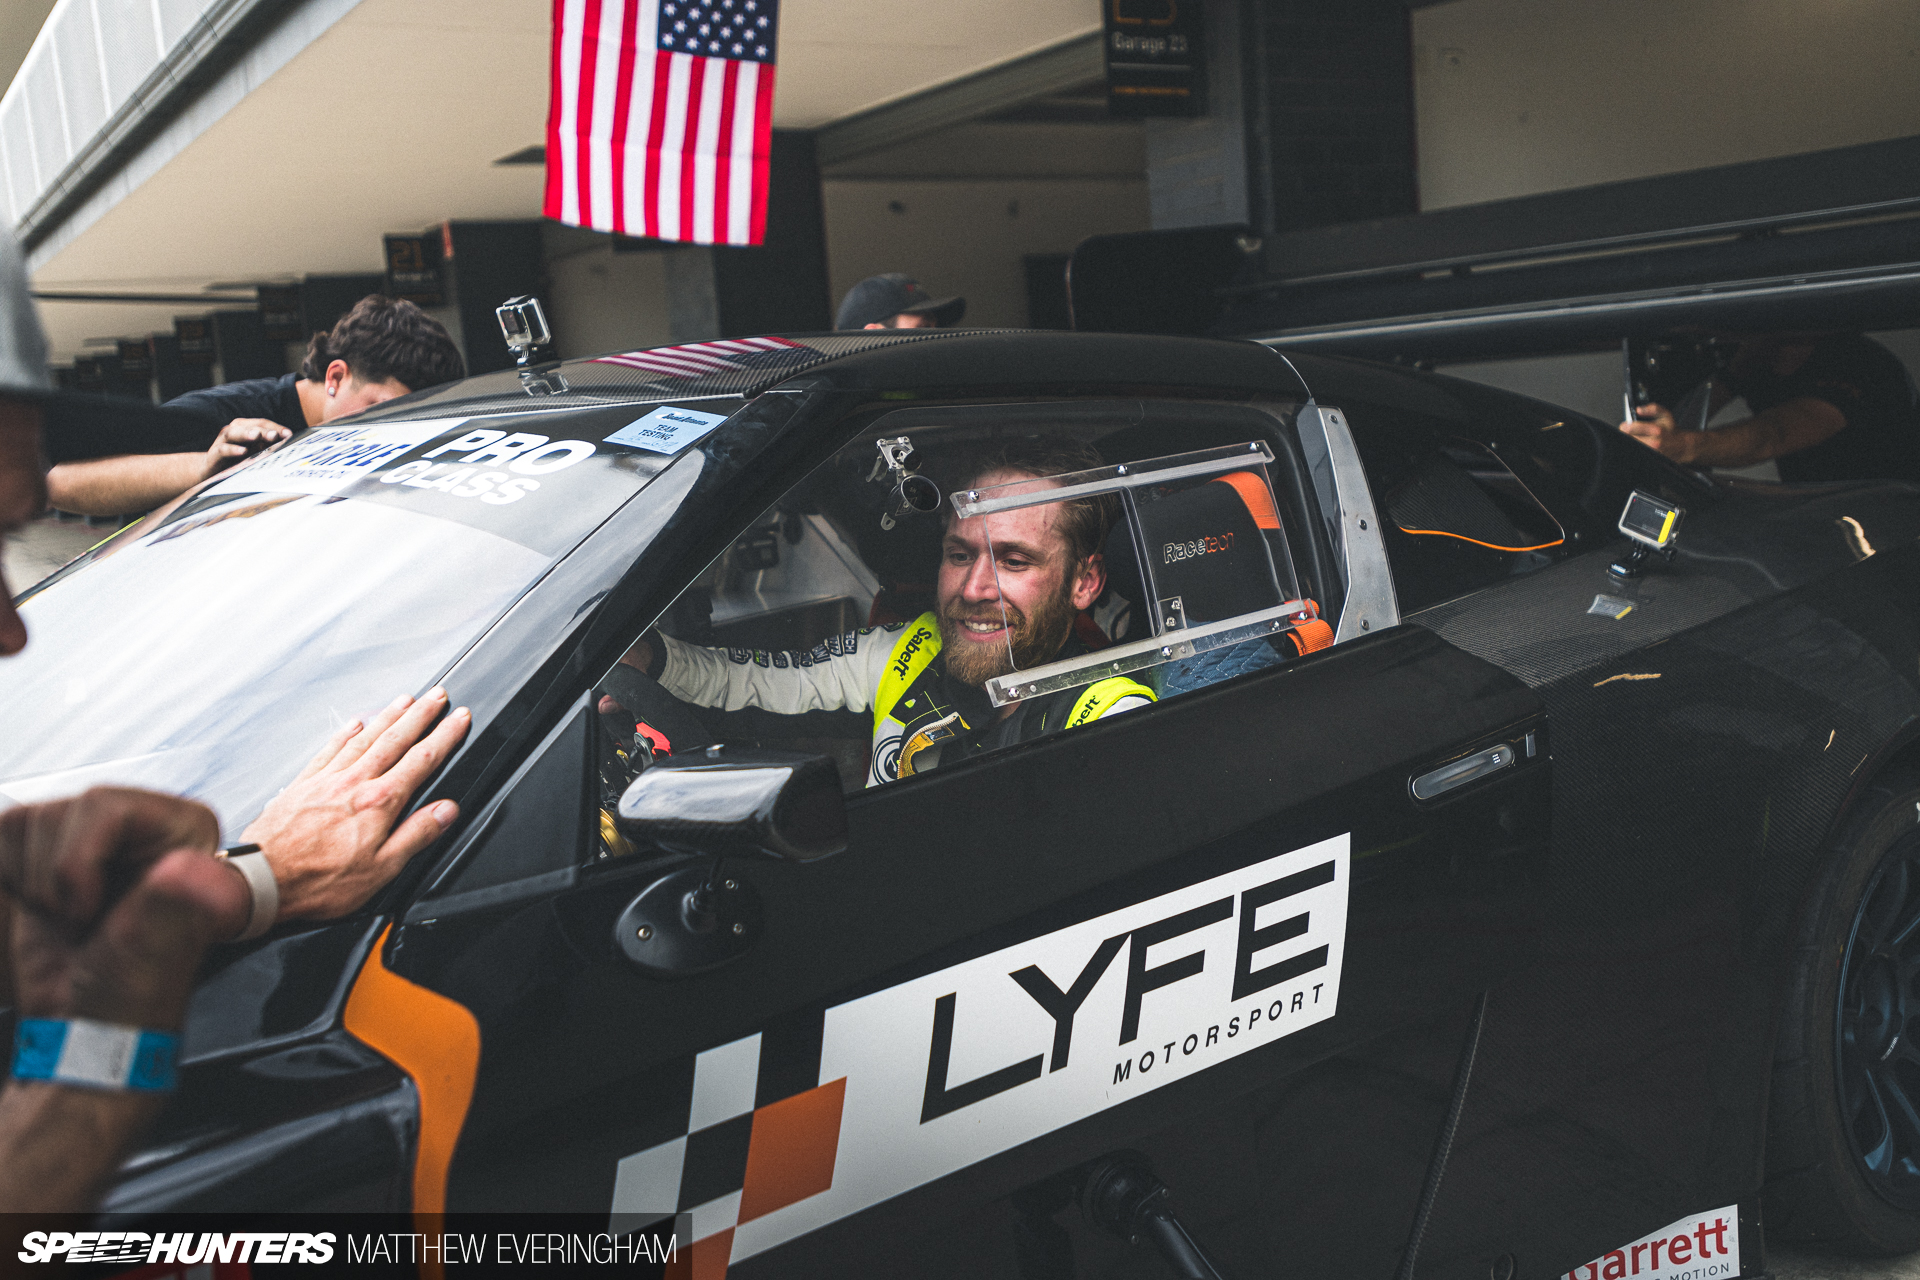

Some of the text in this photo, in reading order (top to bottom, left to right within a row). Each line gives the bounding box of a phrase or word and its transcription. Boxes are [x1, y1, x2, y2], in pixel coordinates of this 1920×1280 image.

[638, 429, 674, 441] TESTING
[654, 424, 679, 433] TEAM
[421, 429, 596, 475] PRO
[380, 459, 541, 505] CLASS
[1163, 530, 1235, 564] Racetech
[893, 627, 932, 680] Sabelt
[1072, 695, 1100, 727] belt
[920, 859, 1336, 1125] LYFE
[1112, 982, 1326, 1086] MOTORSPORT
[1670, 1262, 1729, 1280] MOTION
